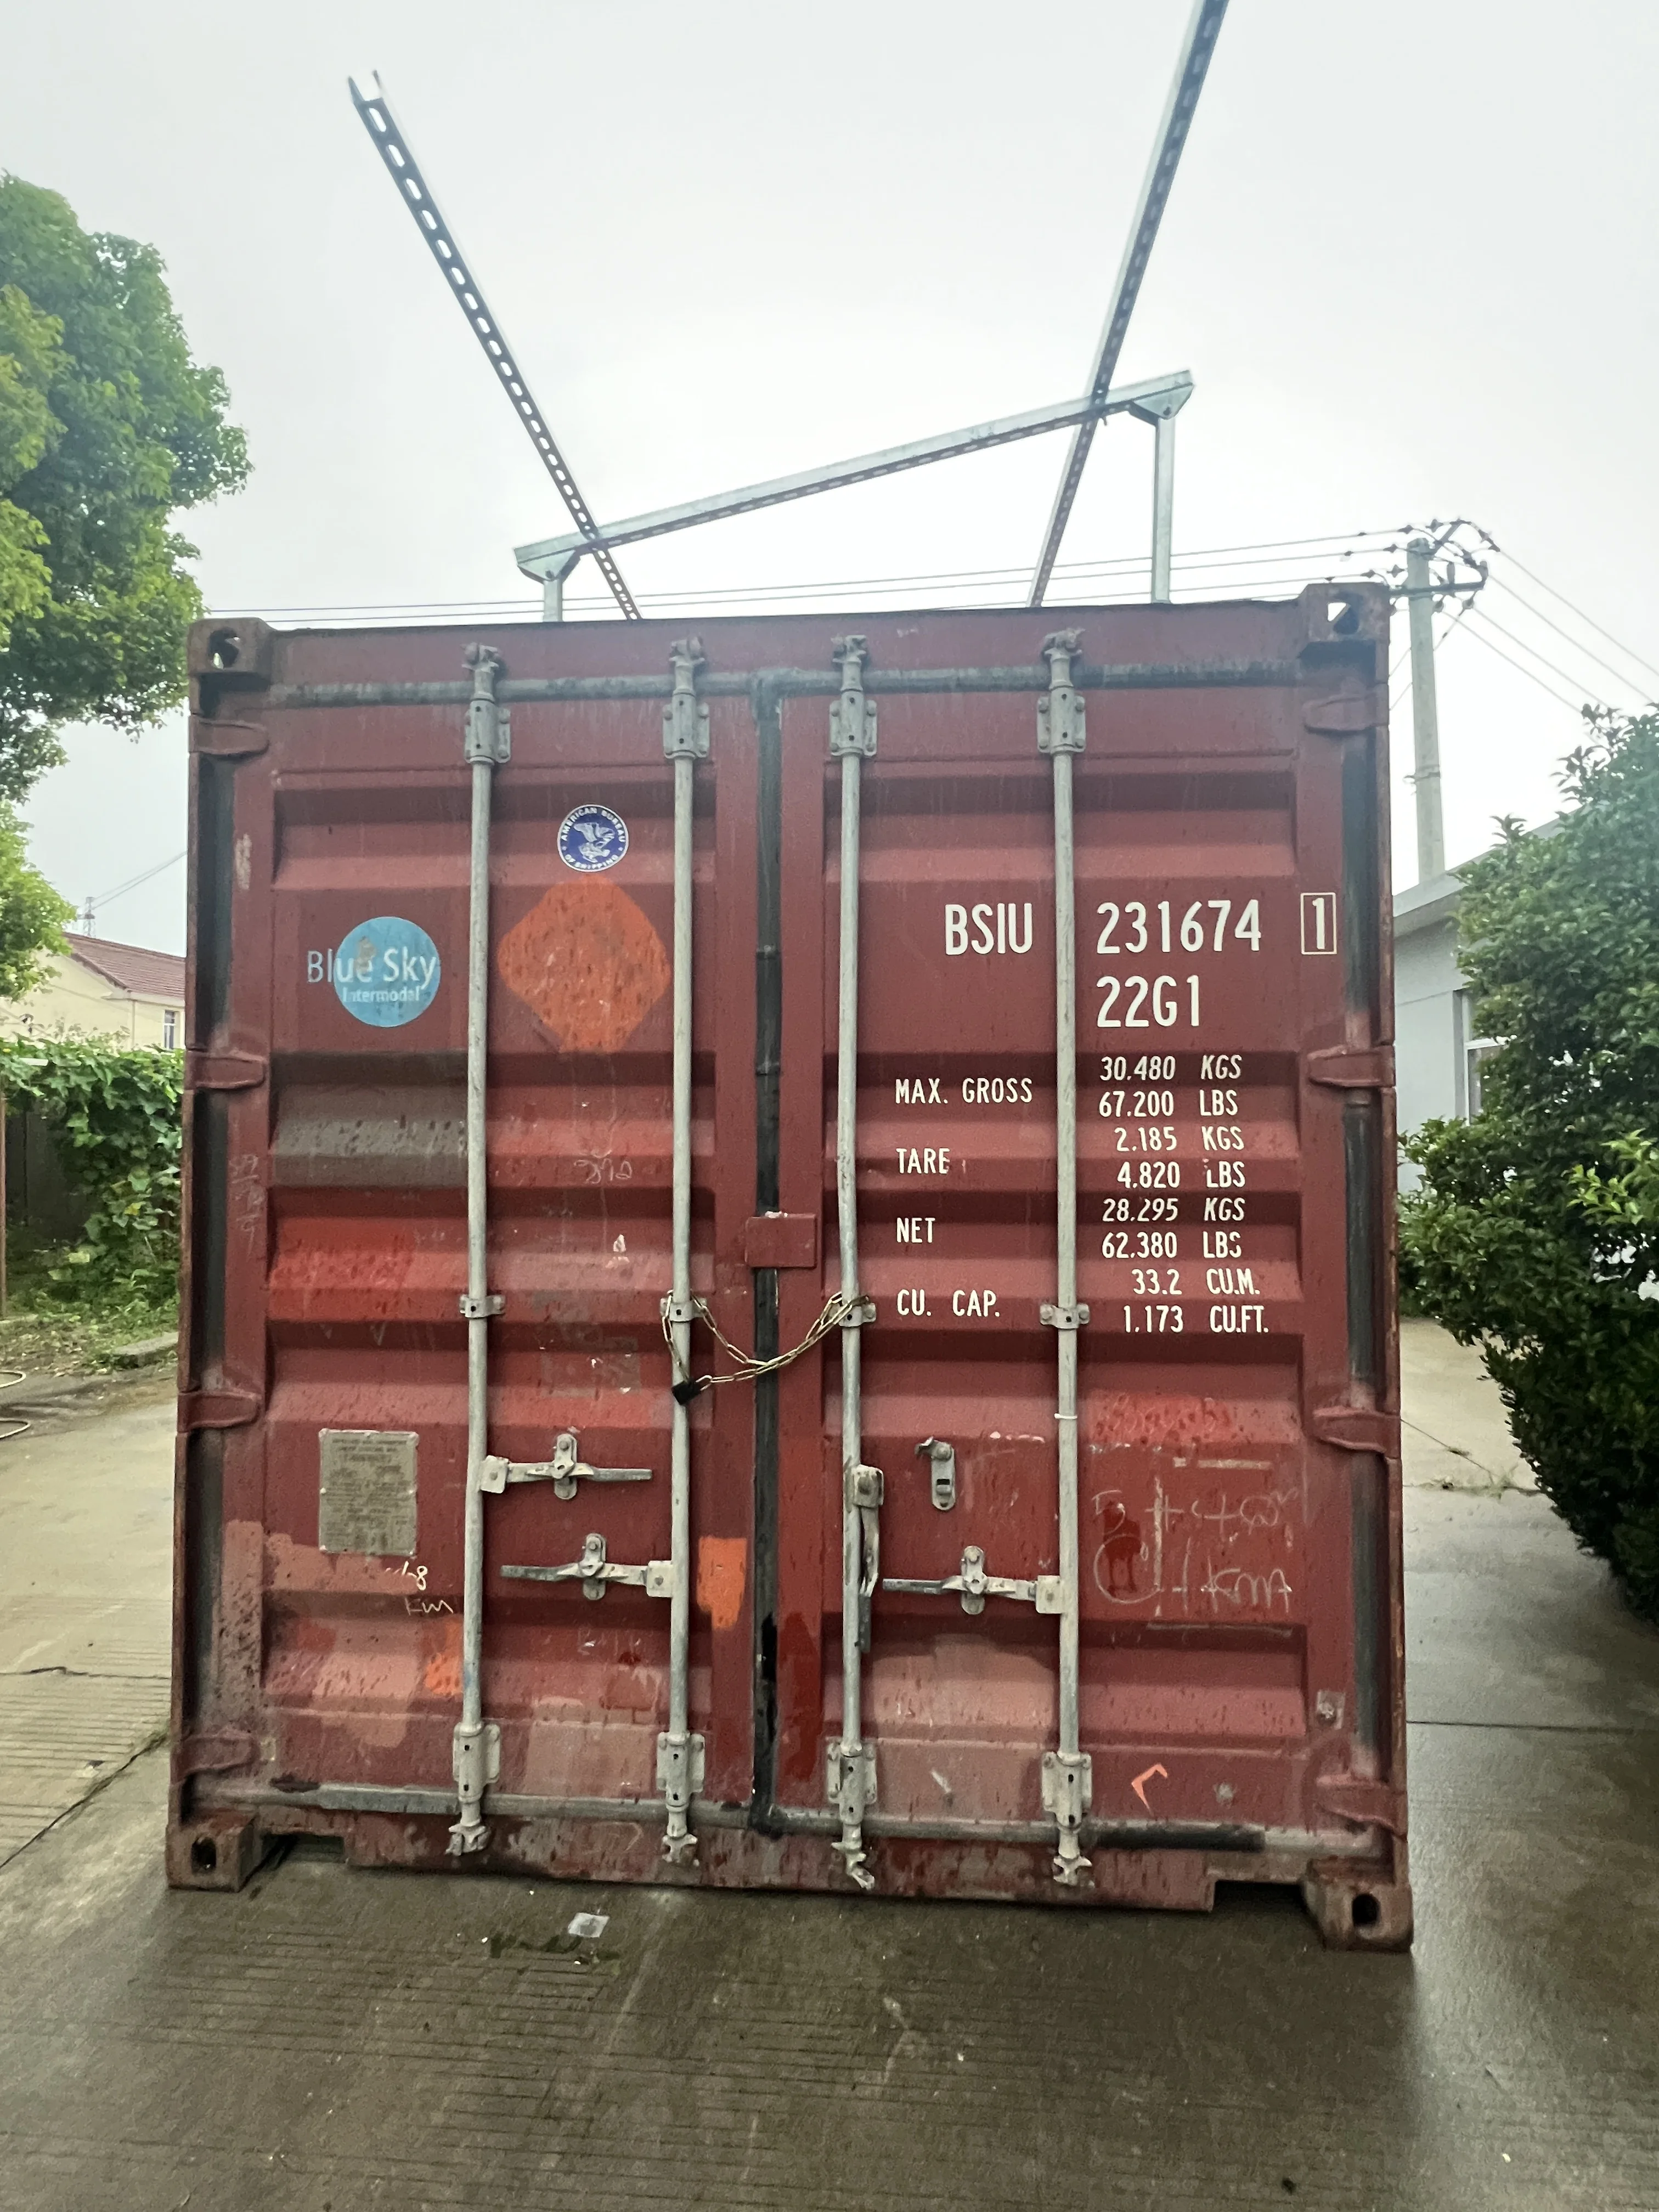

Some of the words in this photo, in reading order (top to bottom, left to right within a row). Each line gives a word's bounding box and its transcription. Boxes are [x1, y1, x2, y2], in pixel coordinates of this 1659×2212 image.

[561, 806, 597, 842] AMERICAN
[601, 809, 626, 843] BUREAU
[574, 854, 619, 870] SHIPPING
[945, 902, 1032, 955] BSIU
[1097, 899, 1261, 954] 231674
[1312, 897, 1326, 950] 1
[307, 949, 374, 983] Blue
[383, 946, 437, 990] Sky
[342, 986, 421, 1003] Intermodal
[1096, 975, 1199, 1028] 22G1
[1099, 1056, 1176, 1081] 30.480
[1200, 1054, 1242, 1080] KGS
[895, 1078, 948, 1104] MAX.
[962, 1077, 1032, 1104] GROSS
[1099, 1090, 1174, 1118] 67.200
[1199, 1090, 1238, 1116] LBS
[1114, 1126, 1177, 1152] 2.185
[1201, 1126, 1244, 1151] KGS
[896, 1148, 950, 1174] TARE
[1117, 1161, 1180, 1189] 4.820
[1206, 1161, 1245, 1188] LBS
[1102, 1198, 1178, 1222] 28.295
[1204, 1197, 1245, 1221] KGS
[896, 1217, 935, 1243] NET
[1102, 1232, 1177, 1259] 62.380
[1203, 1231, 1242, 1258] LBS
[1132, 1268, 1182, 1295] 33.2
[897, 1289, 932, 1316] CU.
[952, 1289, 1000, 1317] CAP.
[1124, 1305, 1183, 1333] 1.173
